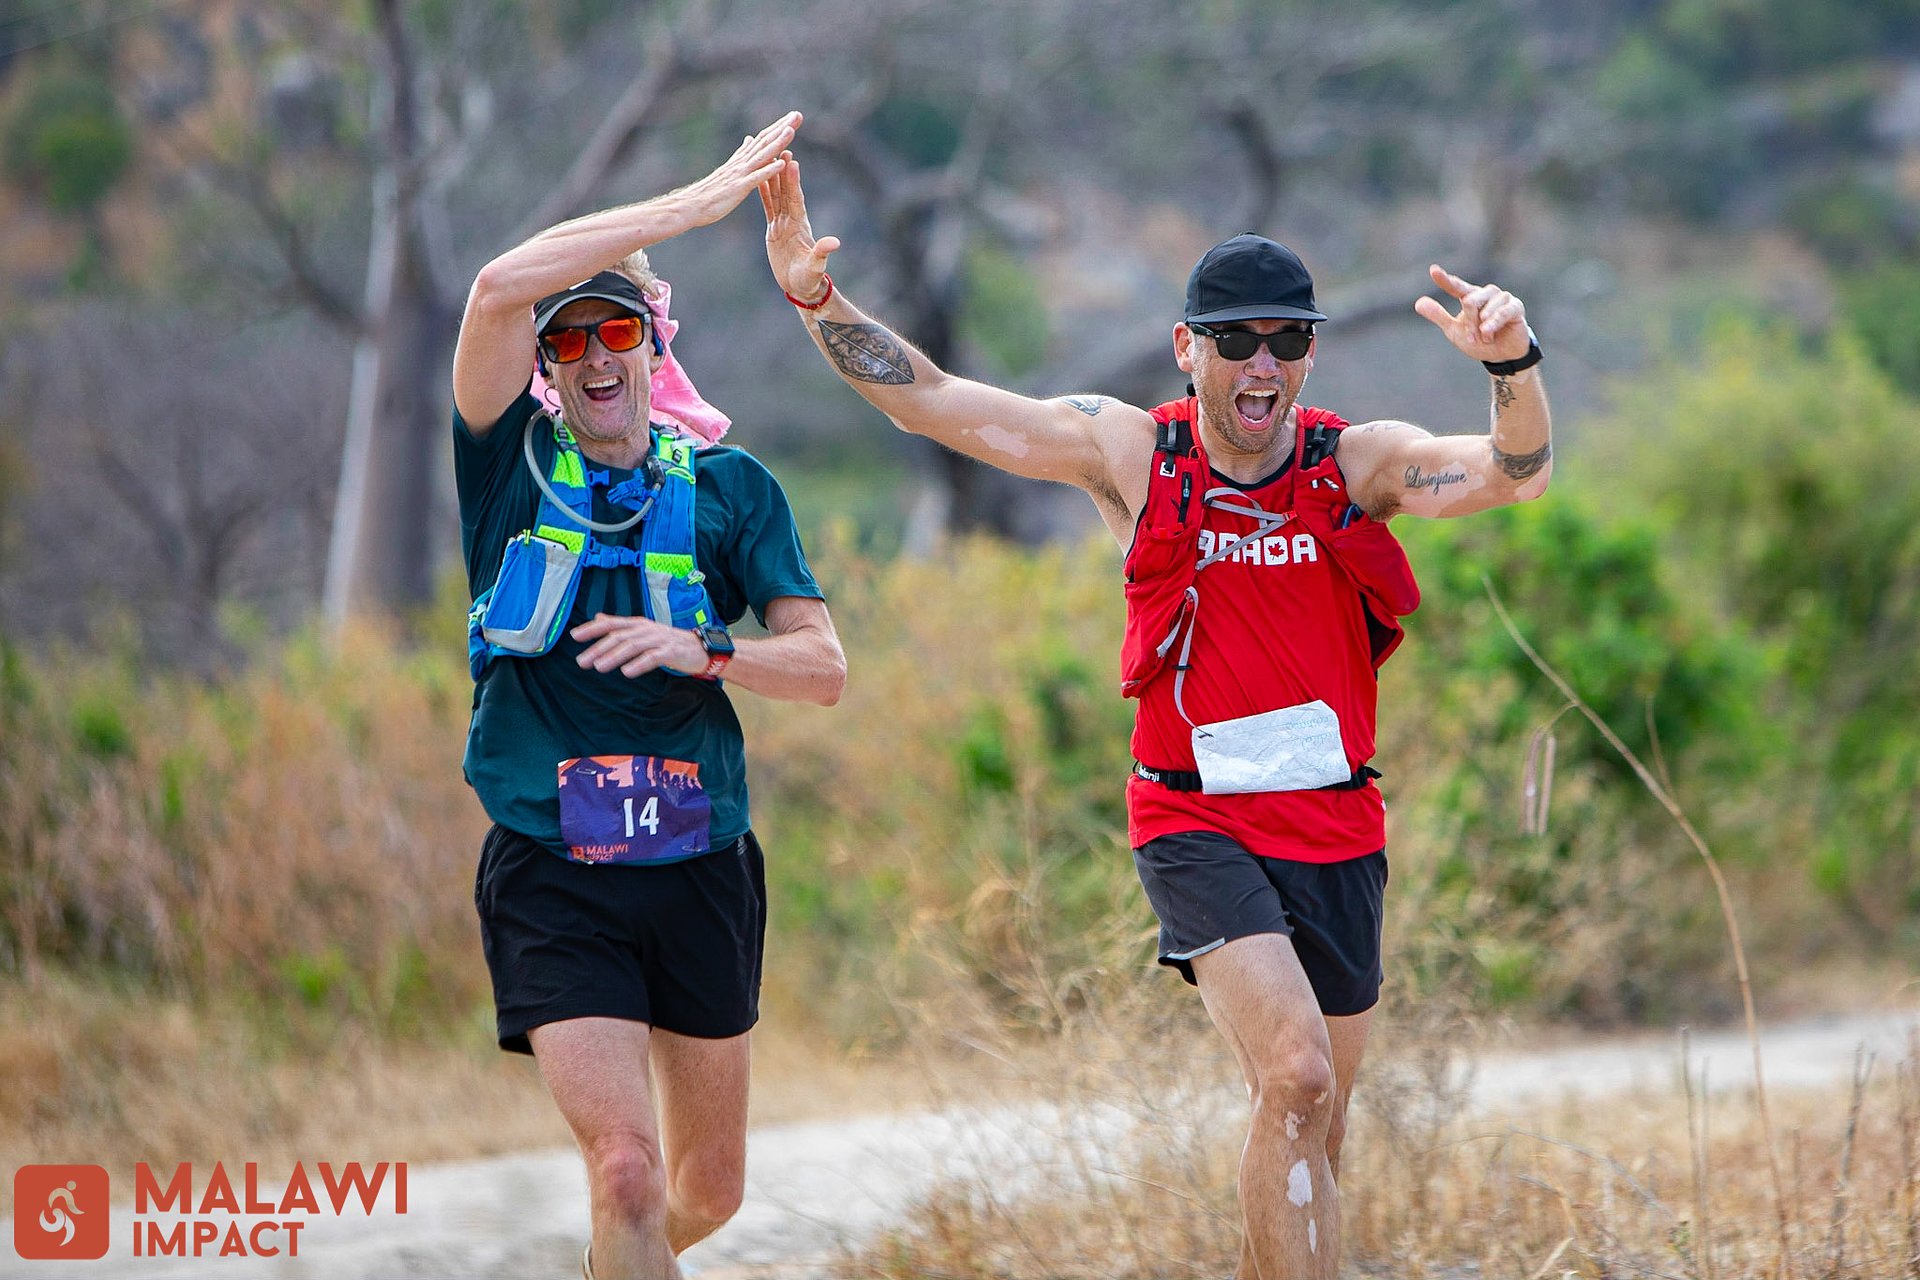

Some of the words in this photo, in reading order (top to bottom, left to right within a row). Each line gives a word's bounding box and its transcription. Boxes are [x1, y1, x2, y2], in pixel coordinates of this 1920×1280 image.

[1198, 529, 1318, 567] ANADA
[623, 796, 660, 838] 14
[586, 844, 629, 856] MALAWI
